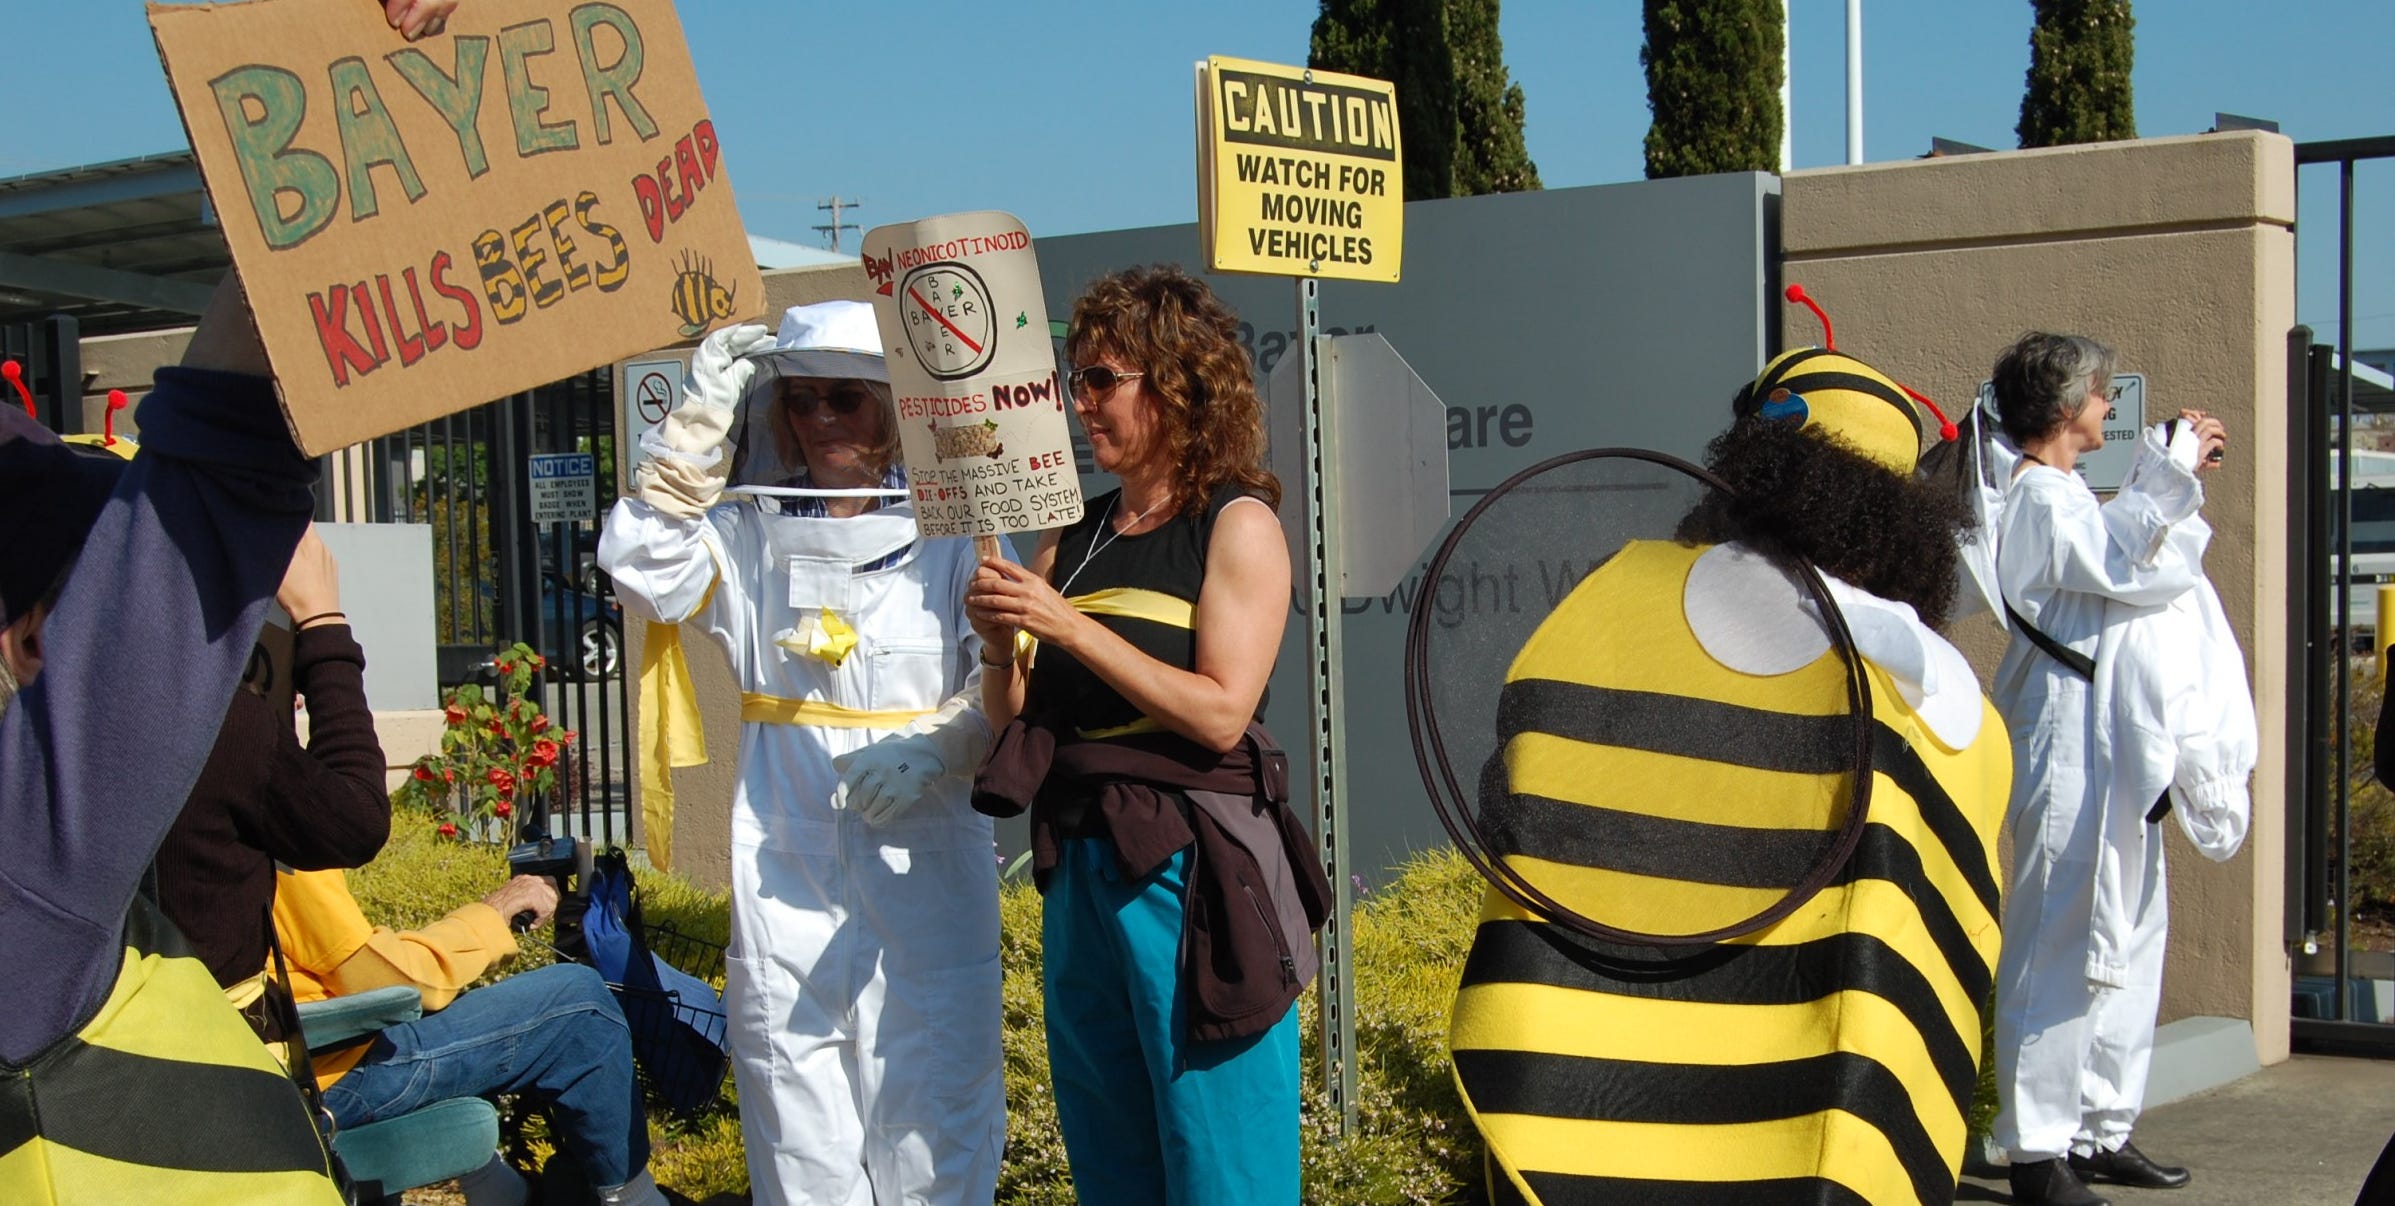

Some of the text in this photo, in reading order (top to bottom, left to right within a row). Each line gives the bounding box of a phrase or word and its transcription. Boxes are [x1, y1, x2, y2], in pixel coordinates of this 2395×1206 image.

[208, 1, 659, 251] BAYER
[1224, 79, 1393, 150] CAUTION
[1236, 153, 1386, 197] WATCH FOR
[1261, 192, 1363, 230] MOVING
[307, 119, 720, 388] KILLS BEES DEAD
[896, 231, 1029, 270] NEONICOTINOID
[1248, 227, 1373, 265] VEHICLES
[910, 302, 977, 326] BAYER
[899, 370, 1063, 420] PESTICIDES NOW!
[533, 457, 592, 476] NOTICE
[939, 470, 960, 484] THE
[961, 459, 1020, 481] MASSIVE
[1029, 451, 1065, 471] BEE
[535, 479, 590, 489] ALL EMPLOYEES
[541, 490, 584, 499] MUST SHOW
[917, 472, 1058, 502] DIE-OFFS AND TAKE
[535, 509, 592, 520] ENTERING PLANT
[566, 500, 587, 508] WHEN
[921, 506, 941, 521] BACK
[946, 504, 975, 520] OUR
[981, 498, 1023, 516] FOOD
[924, 505, 1082, 537] BEFORE IT IS TOO LATE!
